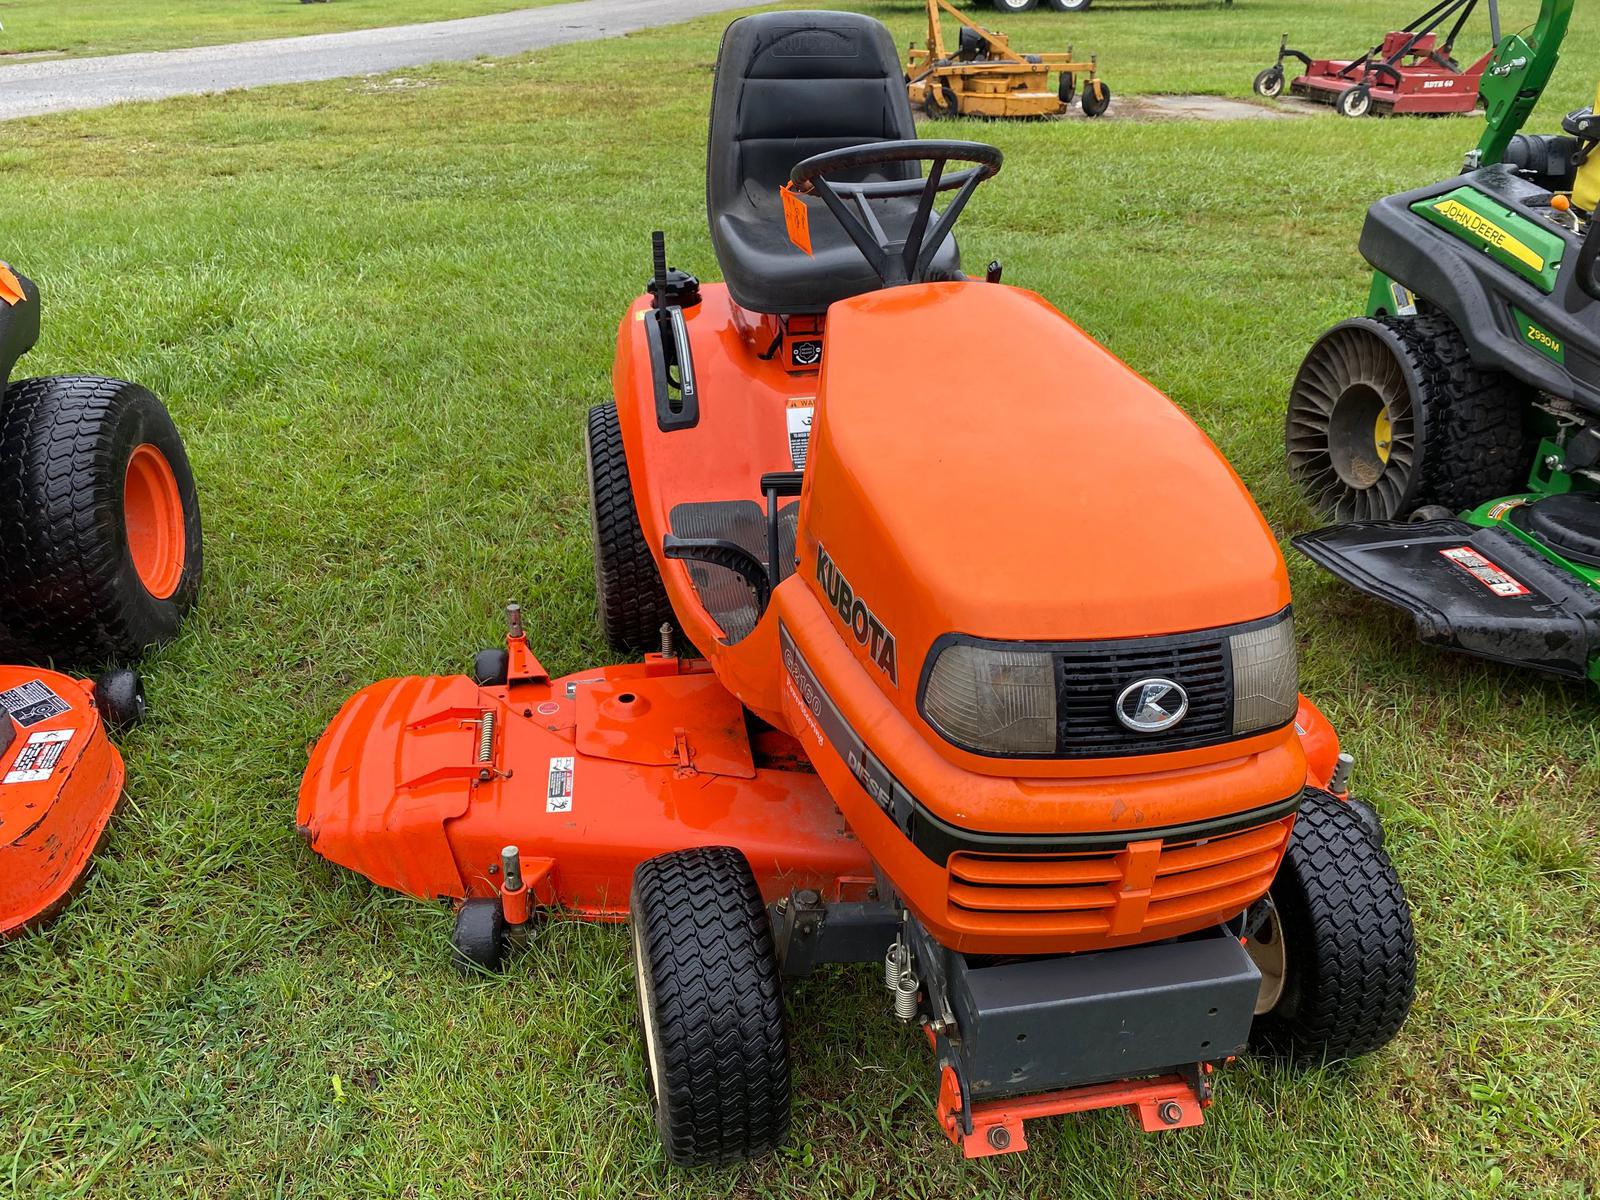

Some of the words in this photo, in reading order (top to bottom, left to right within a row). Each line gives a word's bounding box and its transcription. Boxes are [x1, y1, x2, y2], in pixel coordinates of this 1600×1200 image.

[1444, 79, 1454, 88] 60
[1443, 202, 1471, 226] JOHN
[1471, 217, 1506, 246] DEERE
[1527, 326, 1560, 353] Z930M
[816, 540, 899, 689] KUBOTA
[784, 648, 822, 717] G2160
[847, 750, 896, 820] DIESEL
